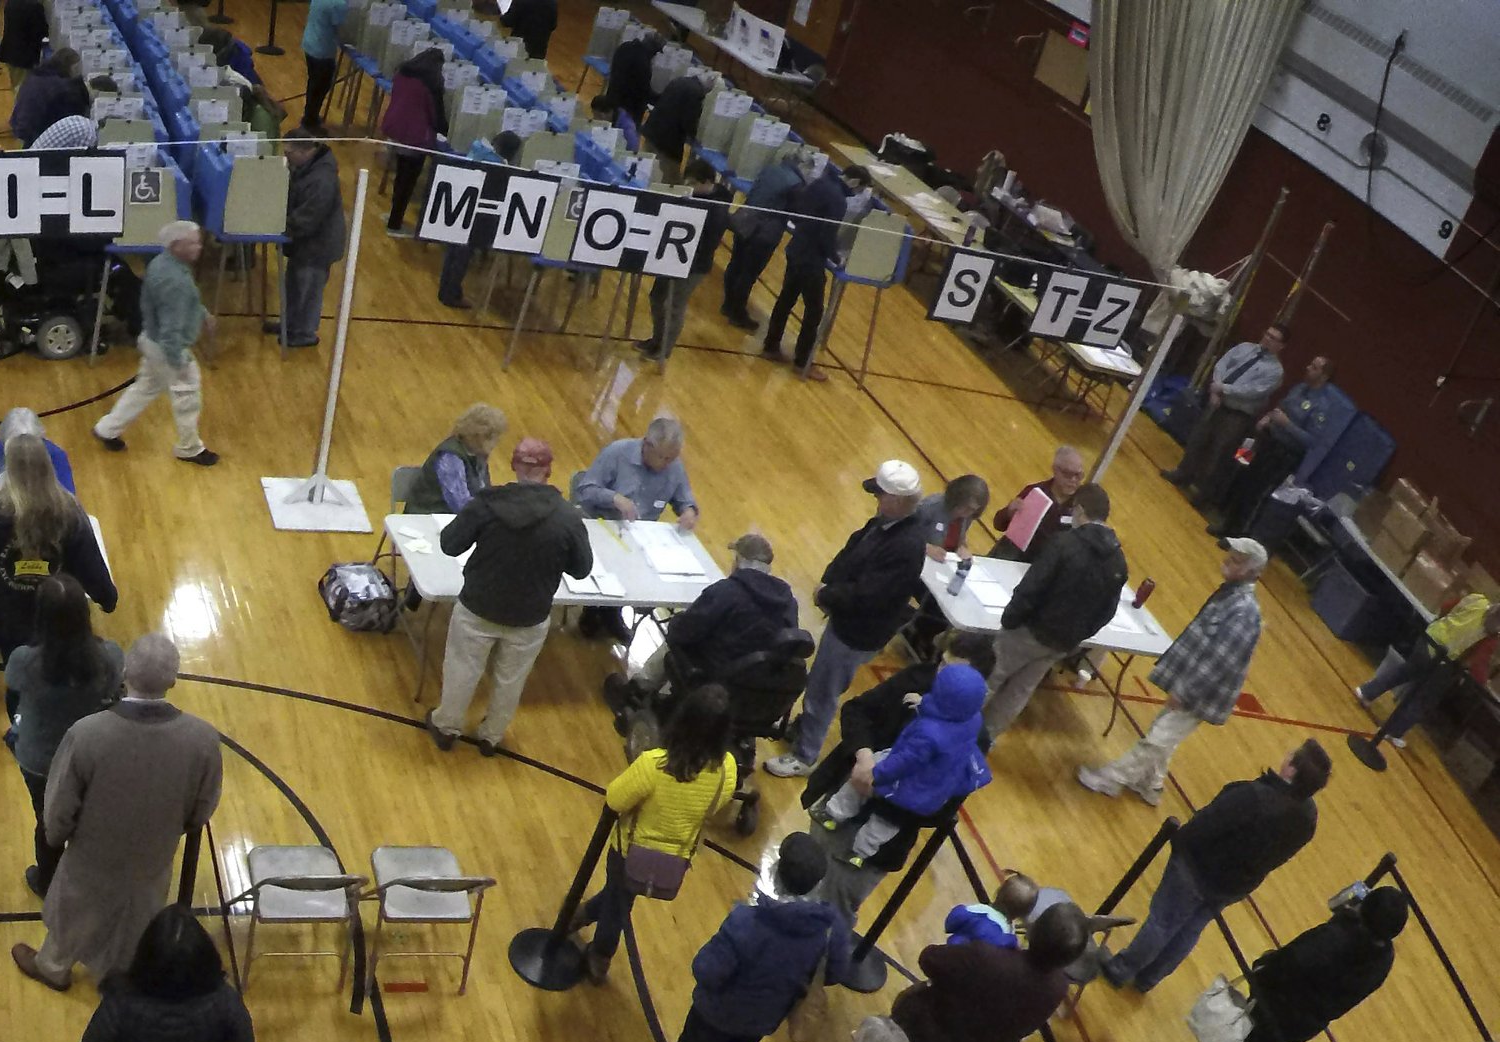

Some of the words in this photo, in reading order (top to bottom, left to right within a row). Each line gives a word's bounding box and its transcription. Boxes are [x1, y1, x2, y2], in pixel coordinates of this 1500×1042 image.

[428, 181, 547, 239] M-N
[583, 208, 696, 264] O-R
[947, 269, 981, 308] S
